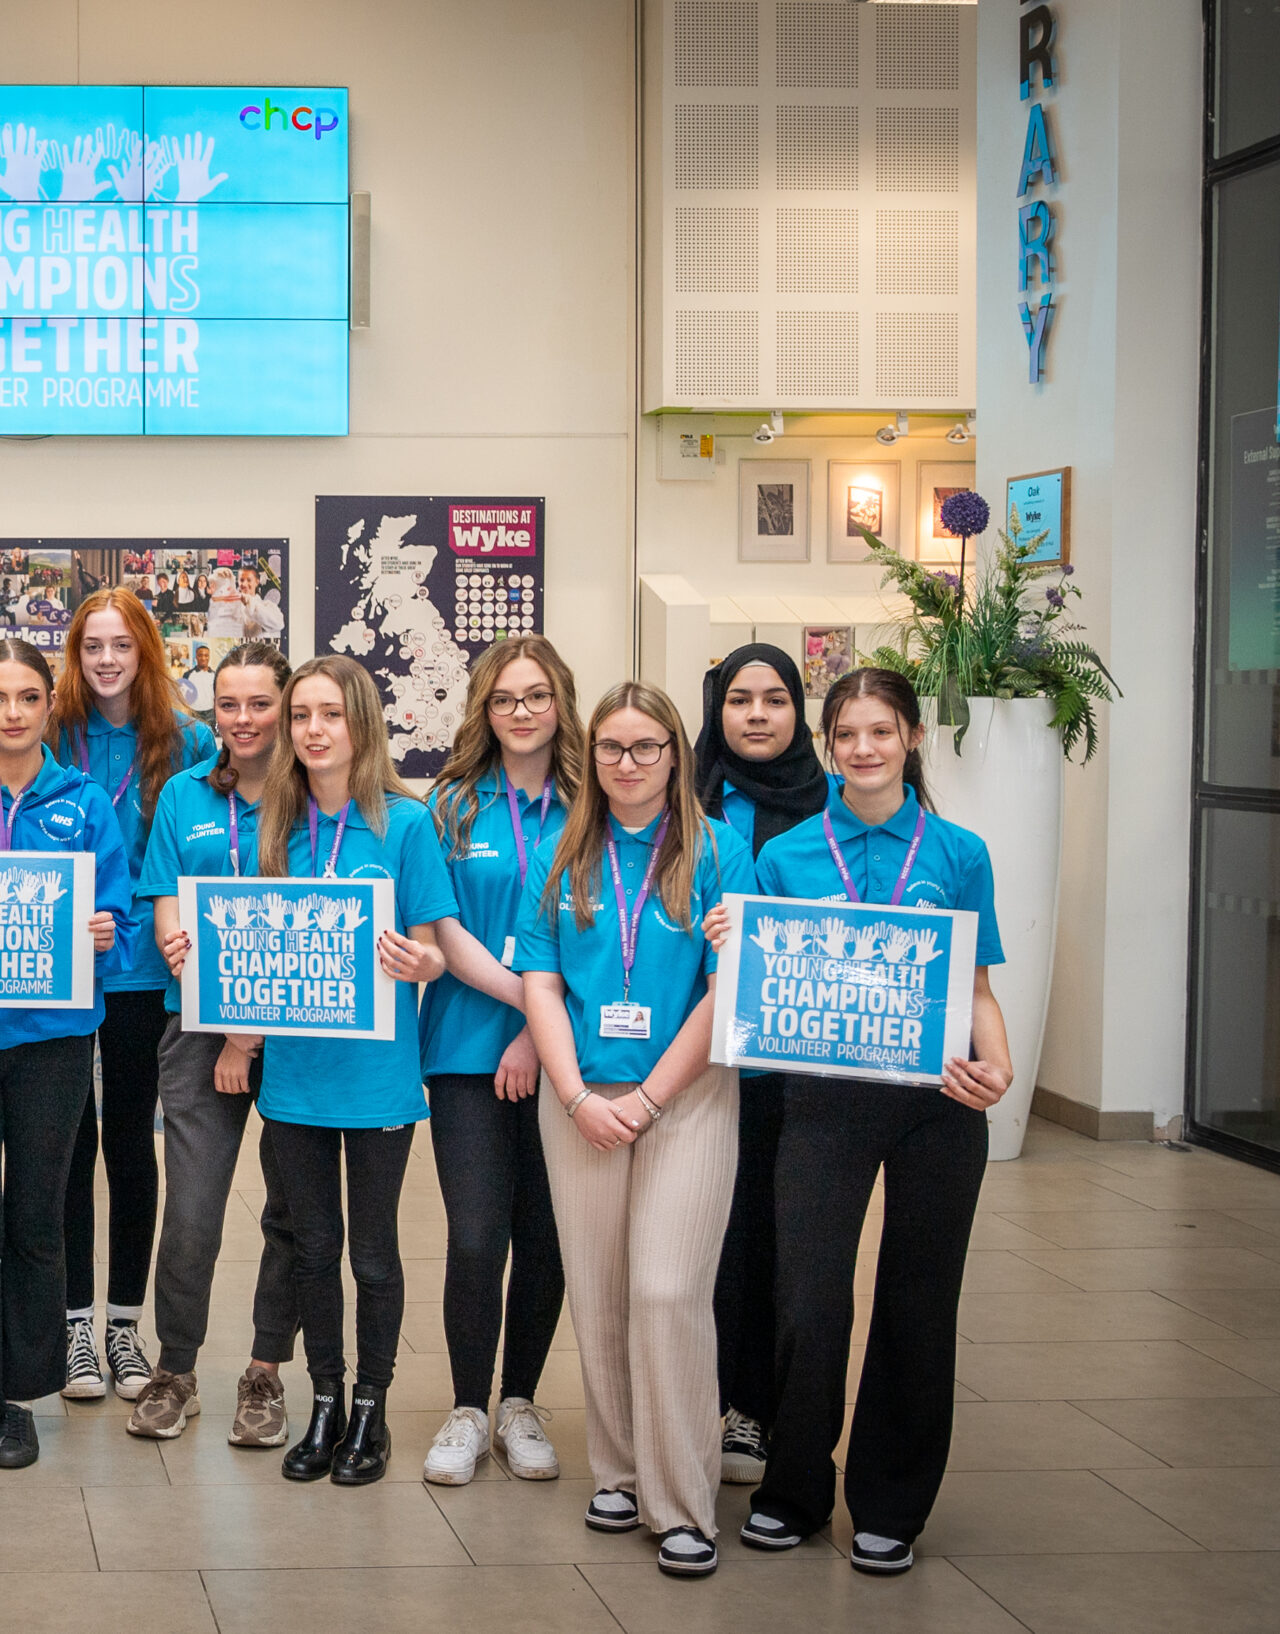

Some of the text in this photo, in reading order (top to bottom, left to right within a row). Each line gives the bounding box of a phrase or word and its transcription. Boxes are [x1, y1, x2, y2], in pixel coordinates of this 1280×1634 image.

[239, 97, 339, 140] chcp
[1016, 0, 1056, 384] RARY
[42, 208, 198, 254] HEALTH
[43, 377, 200, 408] PROGRAMME
[1027, 486, 1040, 497] Oak
[453, 509, 532, 524] DESTINATIONS AT
[453, 525, 531, 553] Wyke
[51, 813, 74, 827] NHS
[192, 821, 216, 832] YOUNG
[186, 828, 225, 842] VOLUNTEER
[217, 930, 355, 953] YOUNG HEALTH
[218, 951, 356, 980] CHAMPIONS
[763, 954, 838, 982] YOUNG
[219, 977, 356, 1008] TOGETHER
[761, 978, 924, 1018] CHAMPIONS
[219, 1004, 356, 1024] VOLUNTEER PROGRAMME
[760, 1006, 923, 1049] TOGETHER
[758, 1036, 920, 1067] VOLUNTEER PROGRAMME
[315, 1394, 334, 1403] HUGO
[355, 1398, 375, 1407] HUGO
